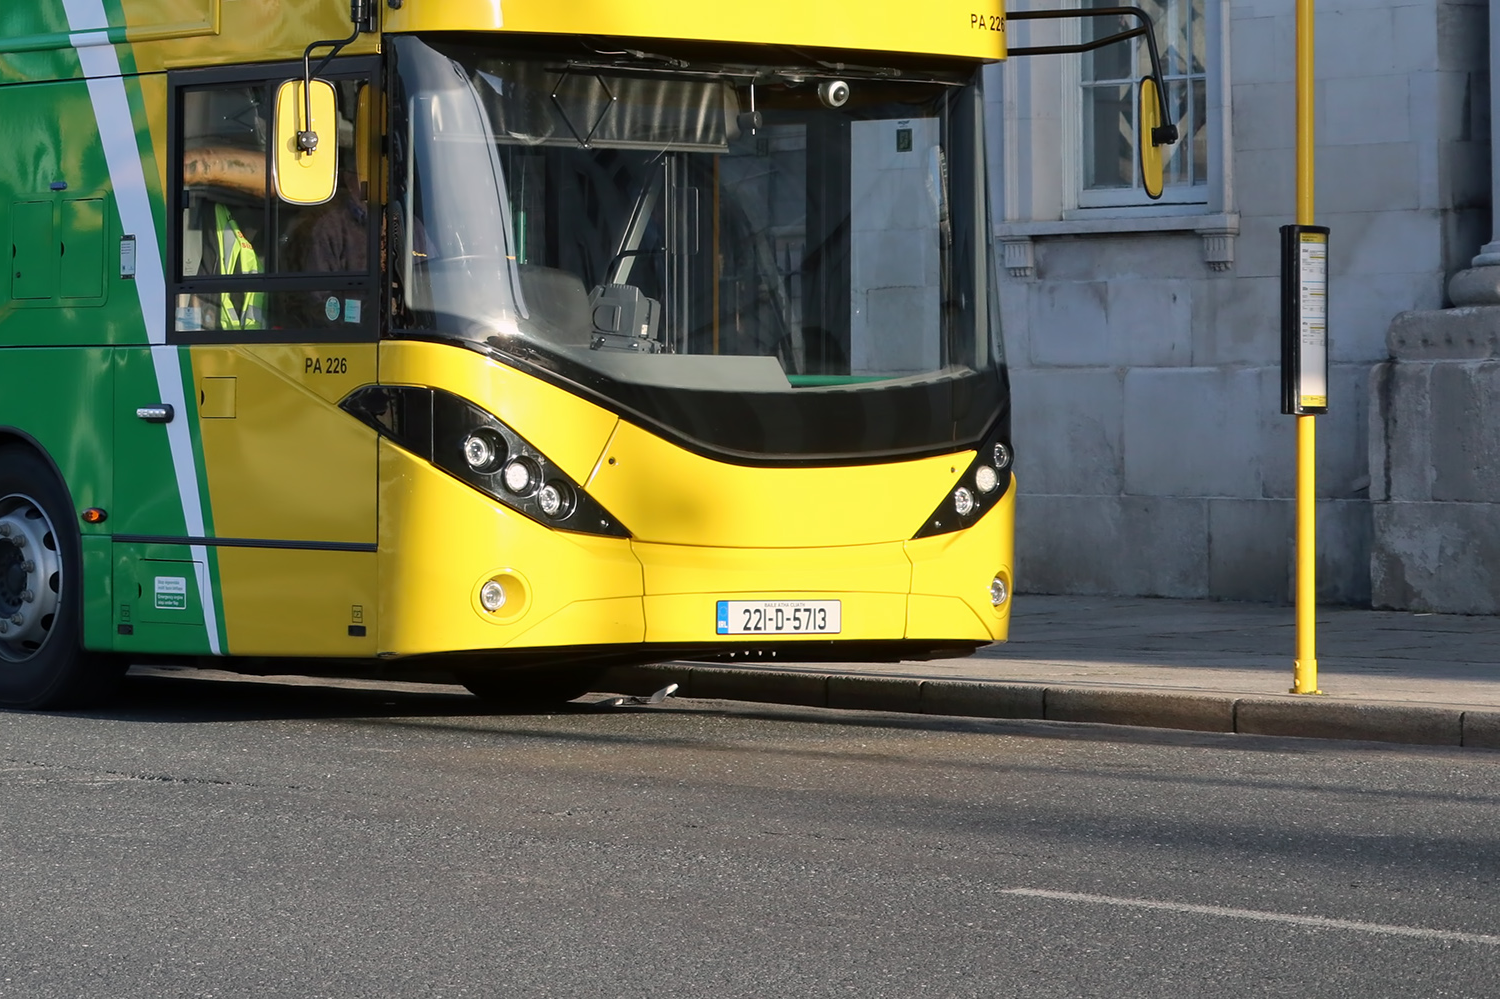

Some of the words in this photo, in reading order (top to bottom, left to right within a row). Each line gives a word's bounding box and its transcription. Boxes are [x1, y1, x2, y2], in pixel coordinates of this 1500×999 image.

[970, 13, 987, 30] PA
[989, 15, 1005, 32] 226
[305, 358, 323, 374] PA
[326, 358, 348, 374] 226
[742, 608, 827, 631] 221-D-5713
